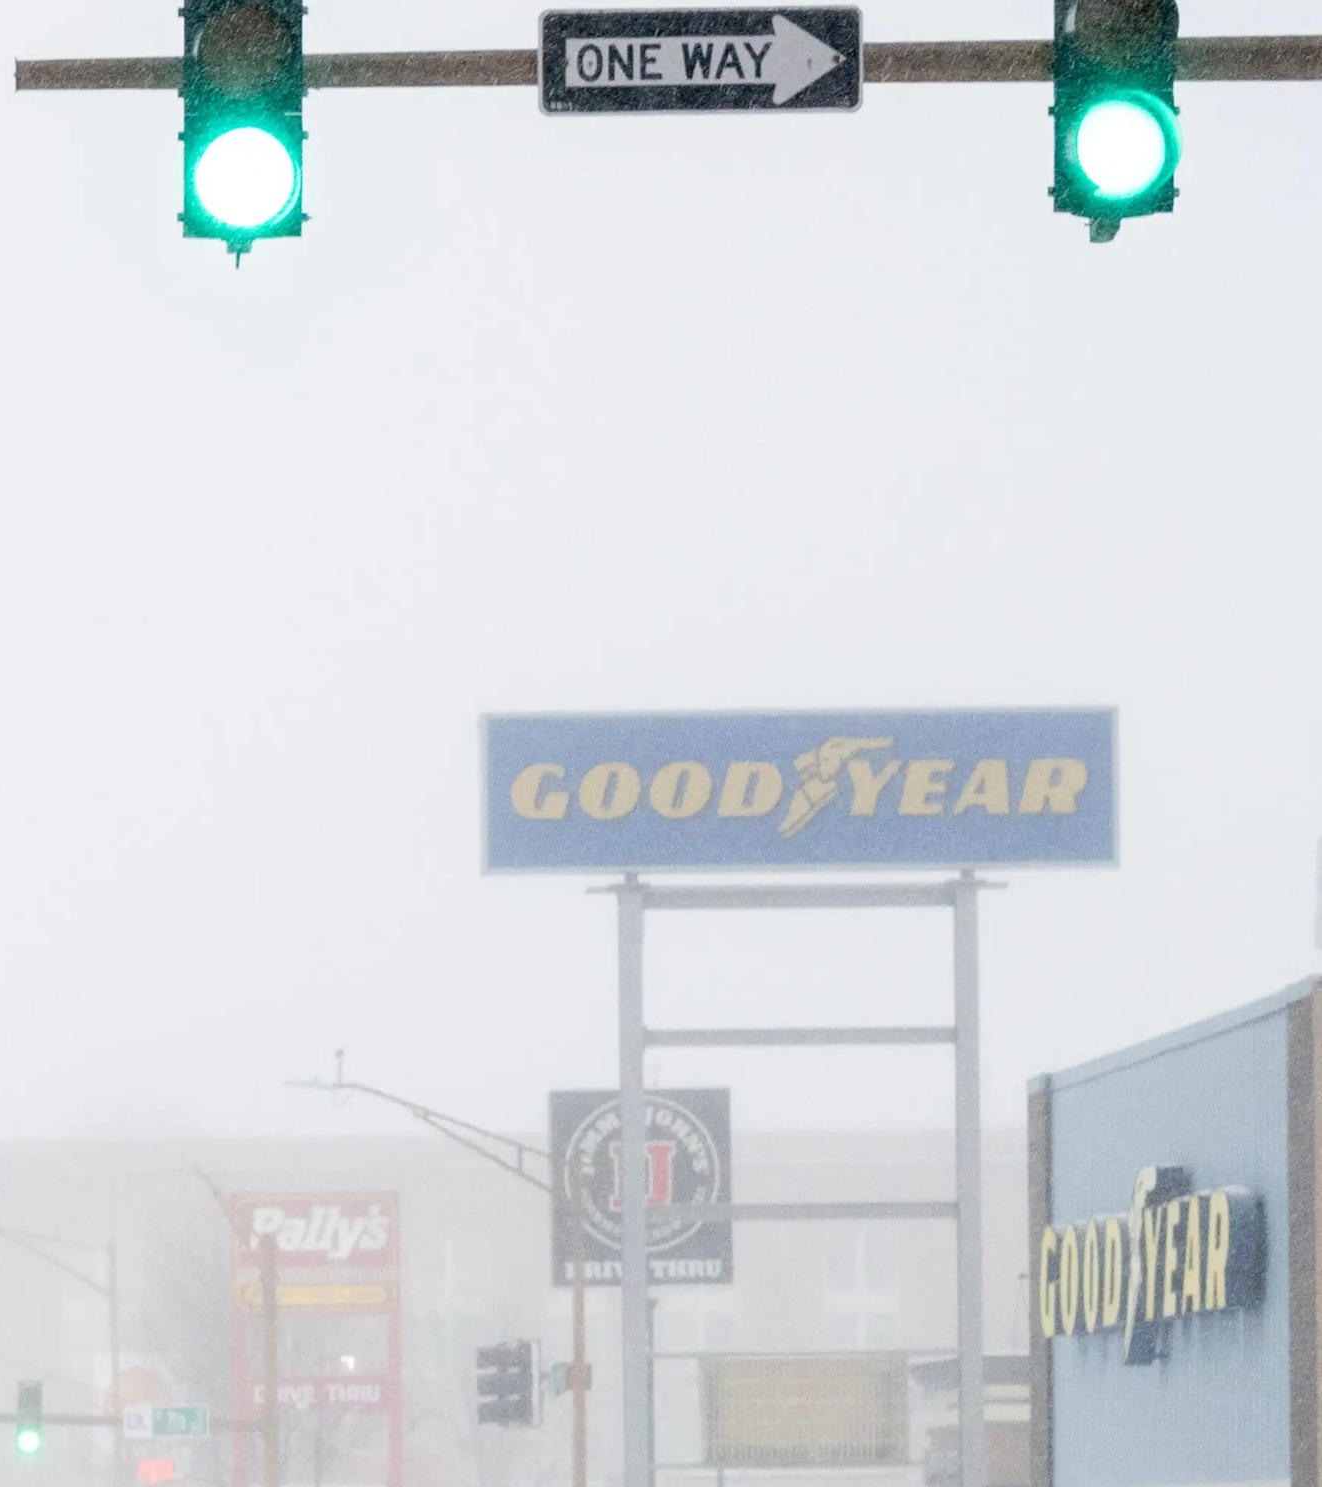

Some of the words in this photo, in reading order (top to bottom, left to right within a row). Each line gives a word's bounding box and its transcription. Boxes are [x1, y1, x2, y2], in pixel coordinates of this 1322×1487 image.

[576, 43, 663, 81] ONE
[681, 41, 774, 80] WAY
[509, 750, 1091, 830] GOODYEAR
[249, 1204, 390, 1260] Rally's
[648, 1258, 725, 1279] THRU
[1039, 1190, 1231, 1340] GOODYEAR
[327, 1383, 383, 1405] THRU
